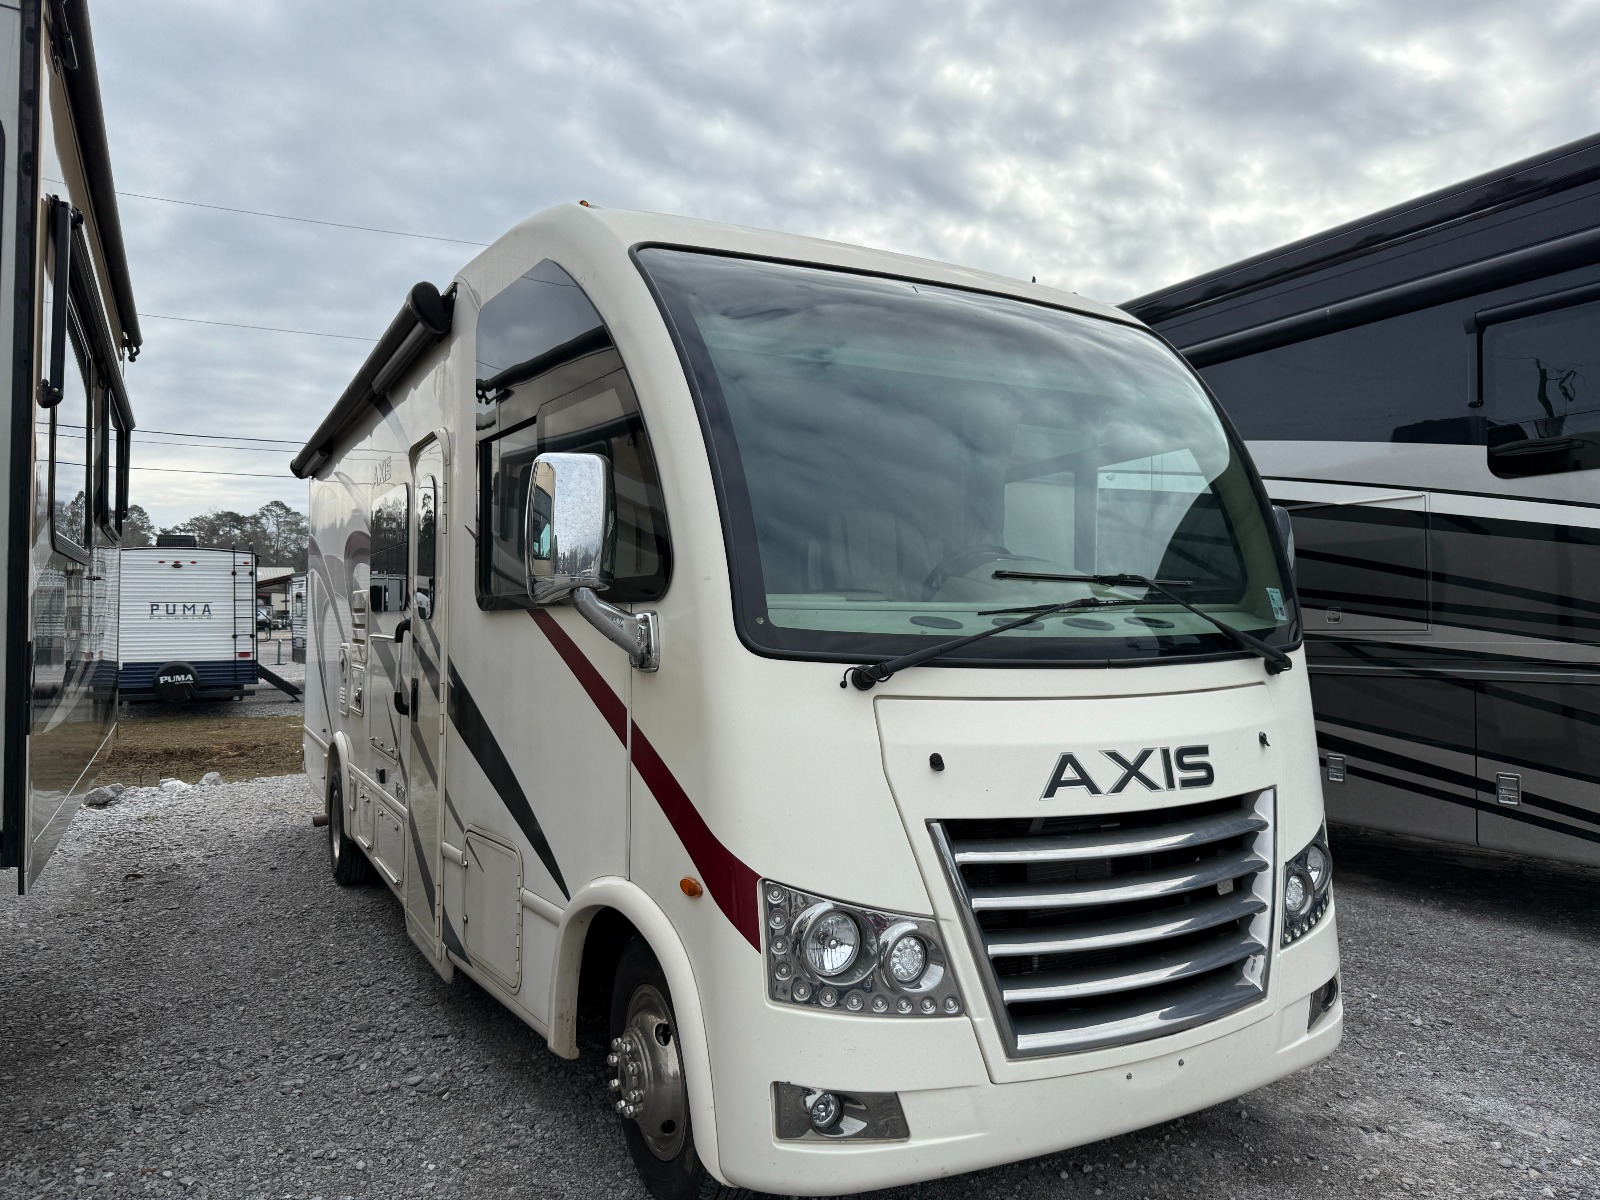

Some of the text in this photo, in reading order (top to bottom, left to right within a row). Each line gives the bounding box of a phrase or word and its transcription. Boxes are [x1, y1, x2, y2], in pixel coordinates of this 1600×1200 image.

[150, 604, 212, 615] PUMA
[159, 674, 194, 684] PUMA
[1039, 744, 1214, 801] AXIS
